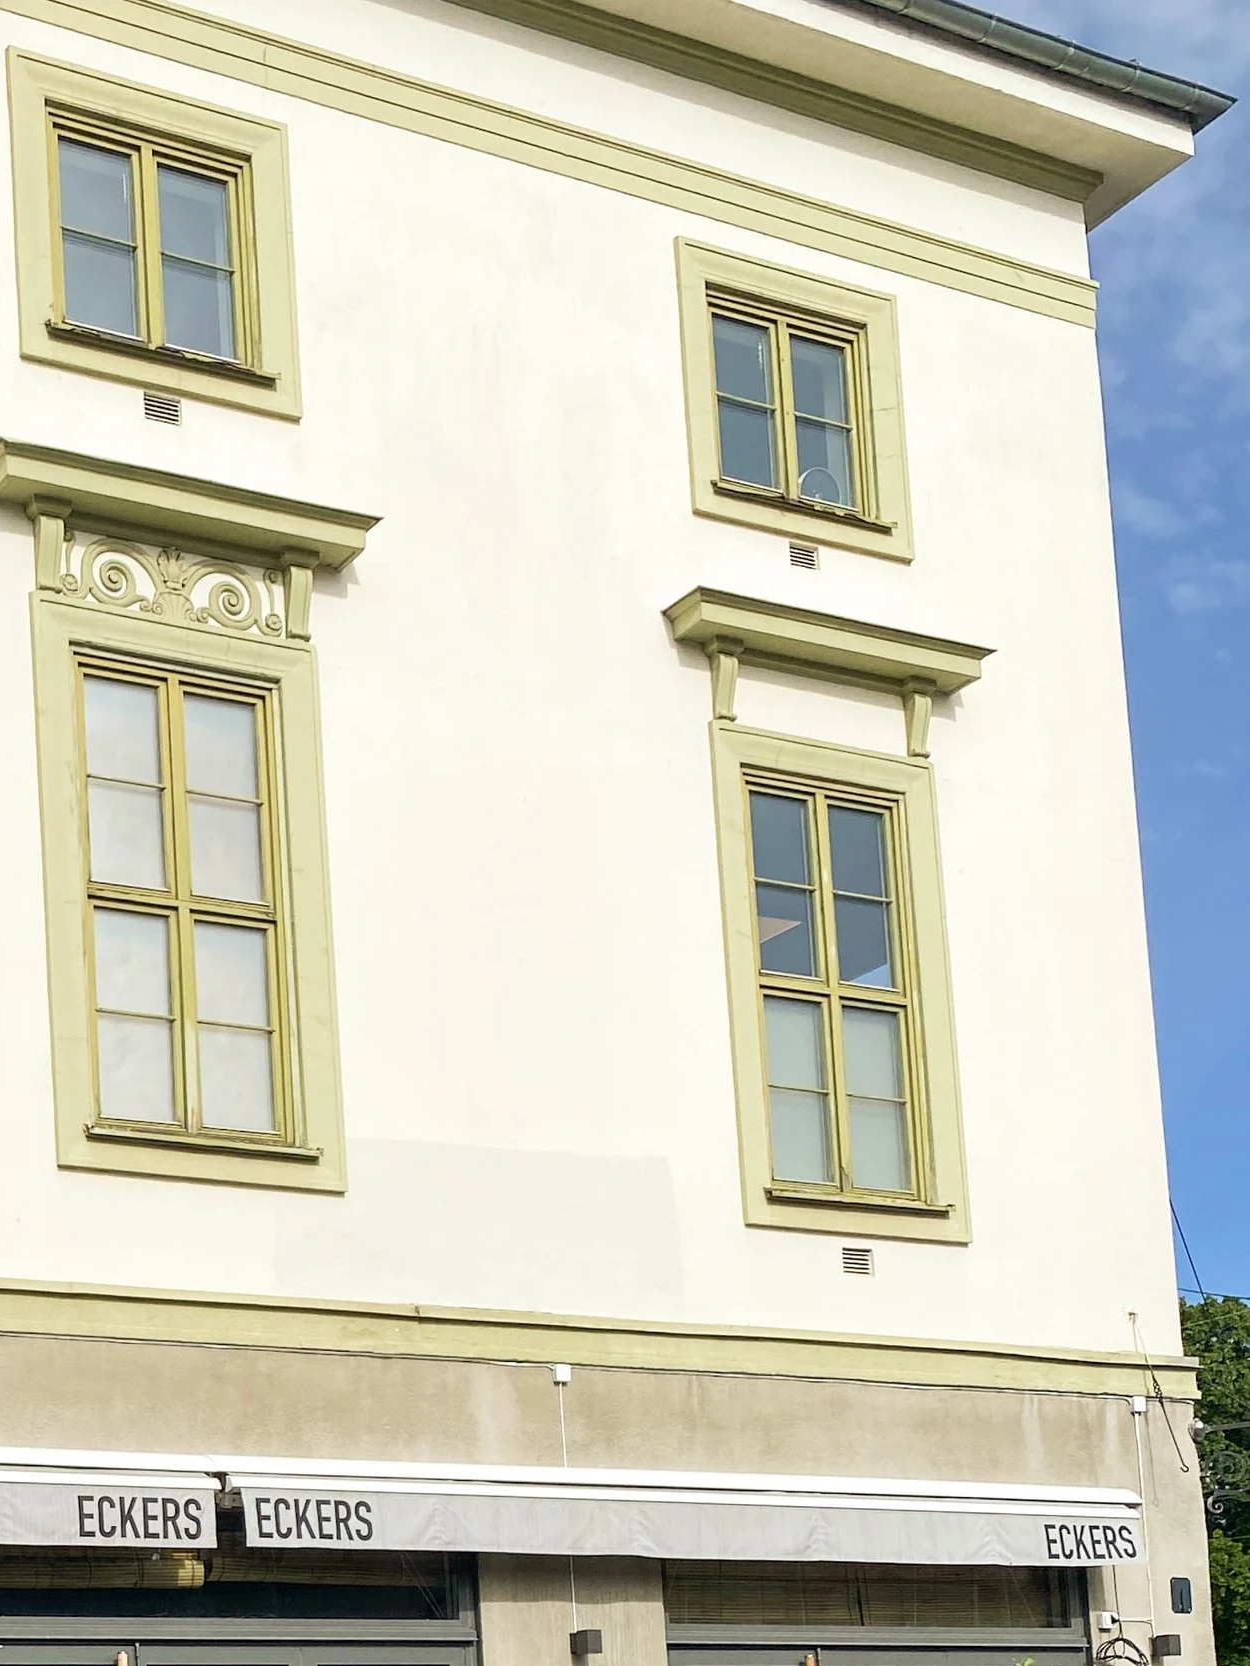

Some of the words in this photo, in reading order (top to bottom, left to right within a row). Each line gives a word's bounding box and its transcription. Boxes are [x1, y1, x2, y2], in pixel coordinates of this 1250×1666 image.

[77, 1495, 202, 1540] ECKERS
[255, 1497, 374, 1541] ECKERS
[1044, 1524, 1137, 1559] ECKERS
